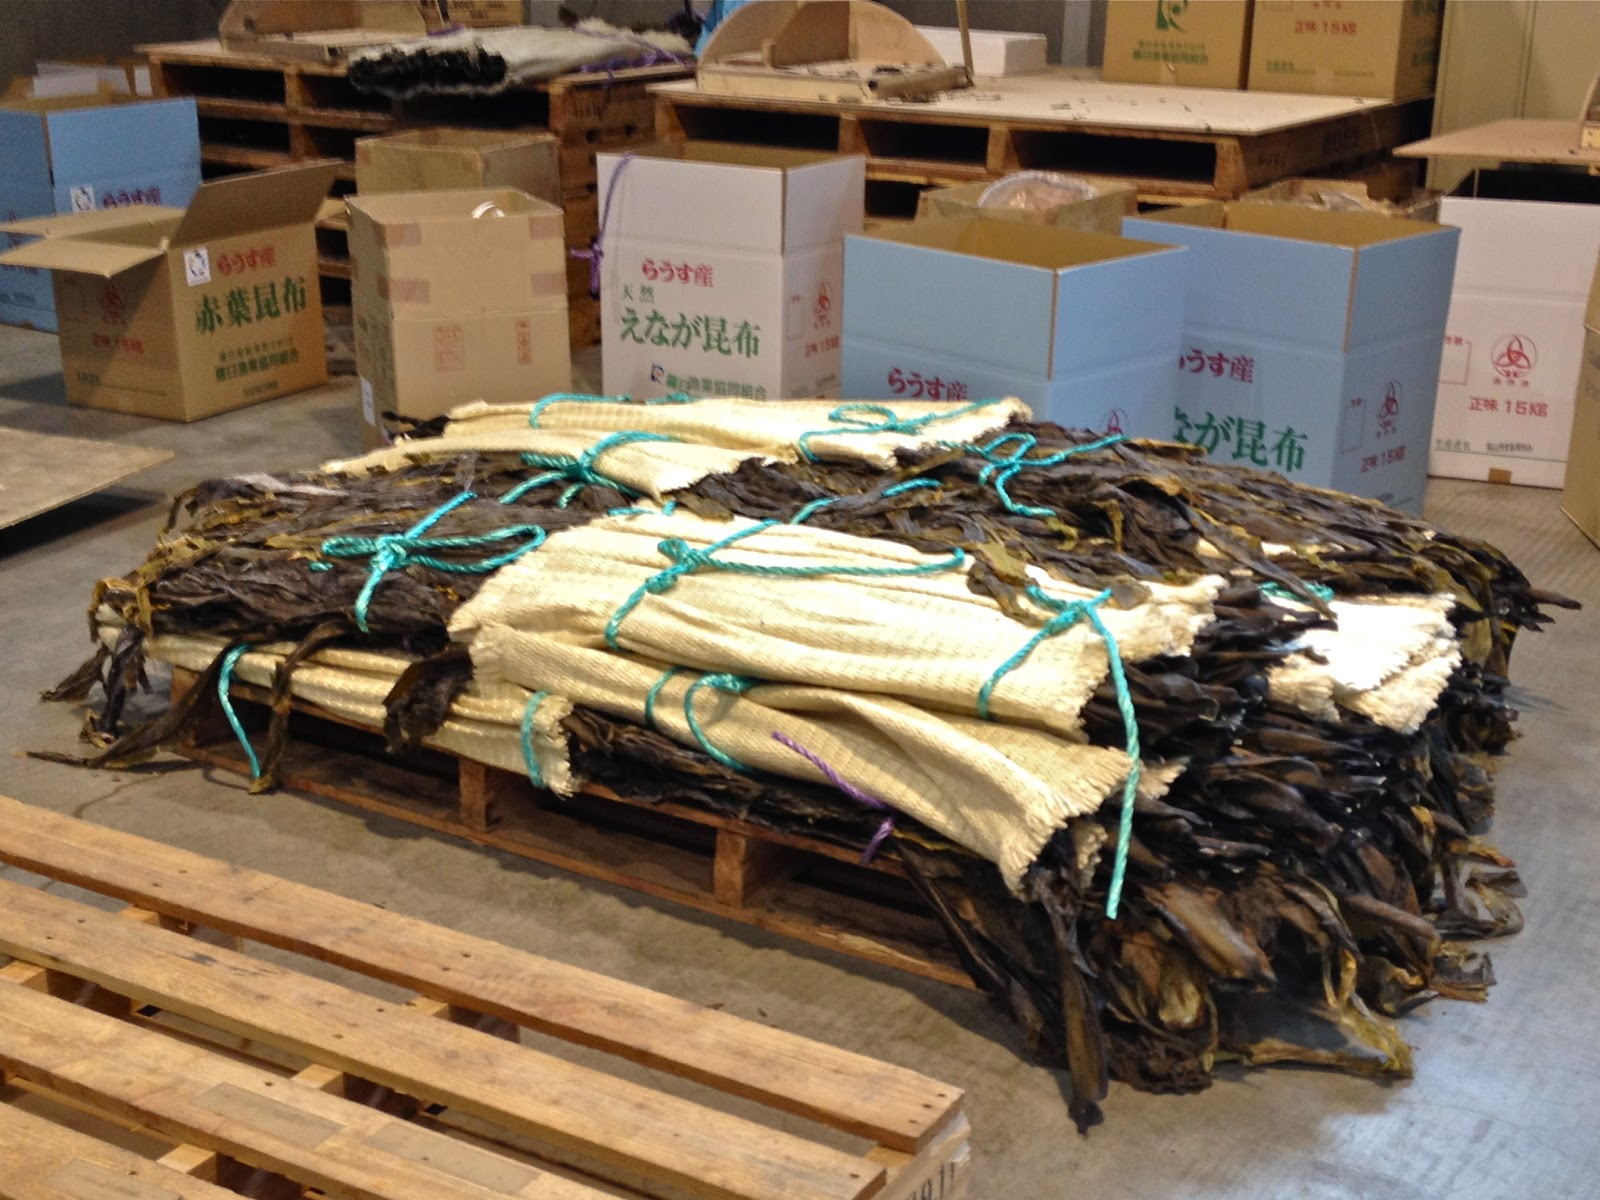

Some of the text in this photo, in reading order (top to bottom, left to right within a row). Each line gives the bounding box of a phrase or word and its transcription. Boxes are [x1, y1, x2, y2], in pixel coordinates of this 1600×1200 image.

[217, 246, 276, 277] らうす産
[641, 257, 714, 288] らうす産
[195, 276, 307, 334] 赤葉昆布
[619, 306, 761, 359] えなが昆布
[887, 367, 968, 402] らうす産
[1469, 395, 1549, 418] 正味 15KG
